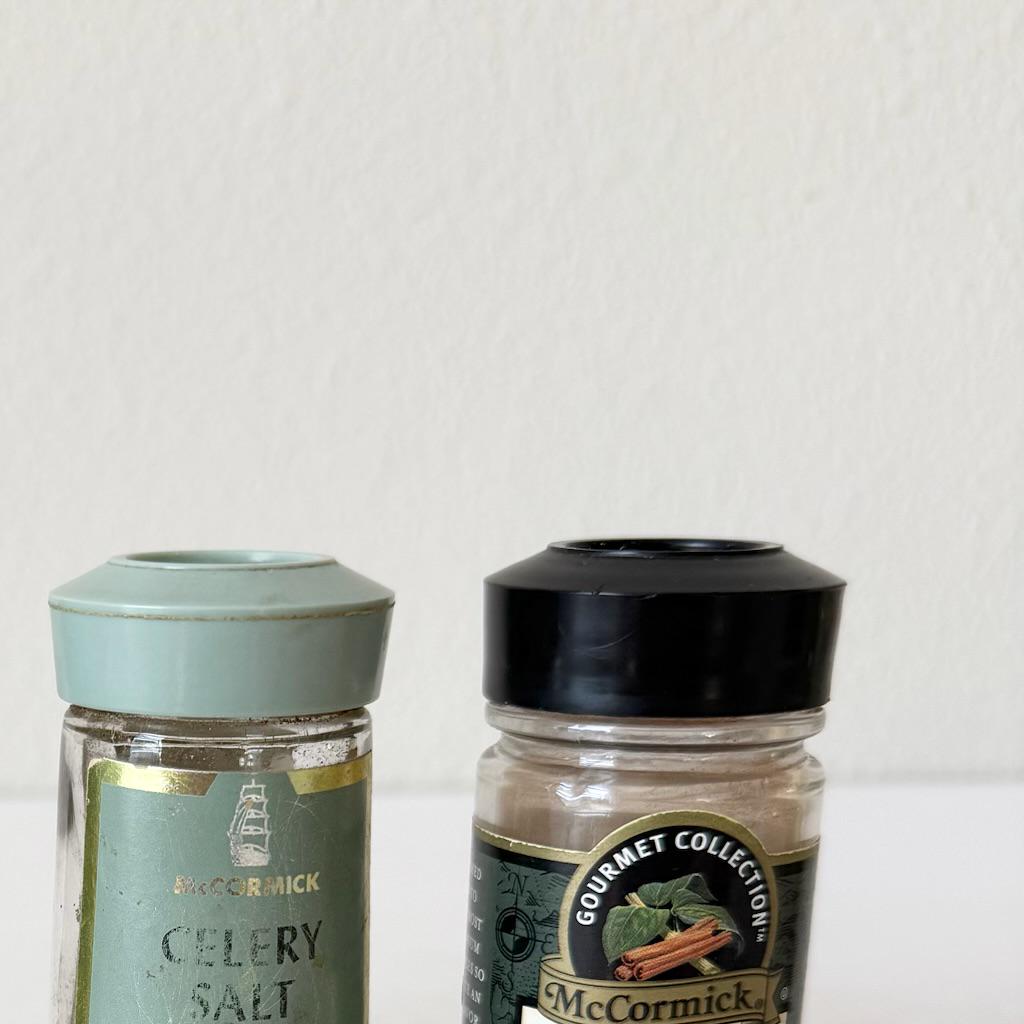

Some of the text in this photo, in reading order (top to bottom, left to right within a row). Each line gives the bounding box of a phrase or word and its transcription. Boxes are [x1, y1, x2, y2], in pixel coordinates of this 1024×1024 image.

[576, 833, 666, 926] GOURMET
[162, 920, 323, 967] CELERY
[190, 980, 295, 1022] SALT
